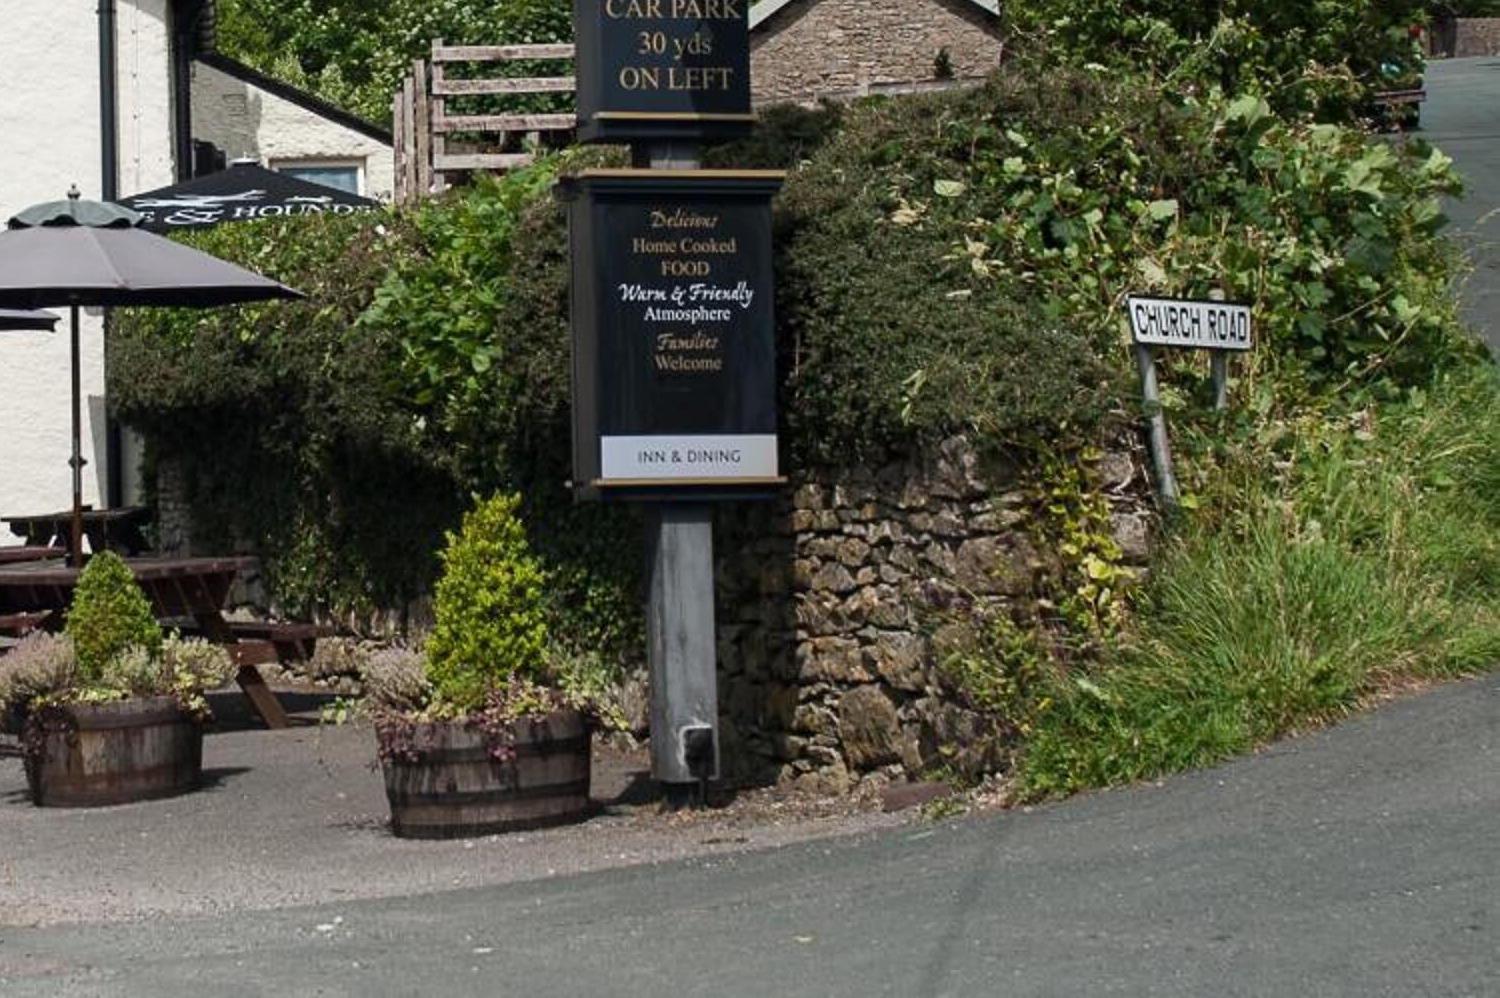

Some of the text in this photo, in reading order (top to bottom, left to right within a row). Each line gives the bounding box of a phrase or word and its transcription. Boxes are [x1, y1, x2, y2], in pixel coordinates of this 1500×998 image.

[638, 31, 712, 59] 30 yds
[619, 67, 733, 90] ON LEFT
[164, 209, 225, 224] &
[651, 208, 718, 228] Delicious
[633, 238, 736, 253] Home Cooked
[661, 261, 710, 277] FOOD
[618, 281, 754, 308] Warm & Friendly
[643, 306, 731, 324] Atmosphere
[1135, 304, 1247, 343] CHURCH ROAD
[657, 330, 719, 351] Families
[655, 355, 722, 371] Welcome
[638, 449, 741, 463] INN & DINING
